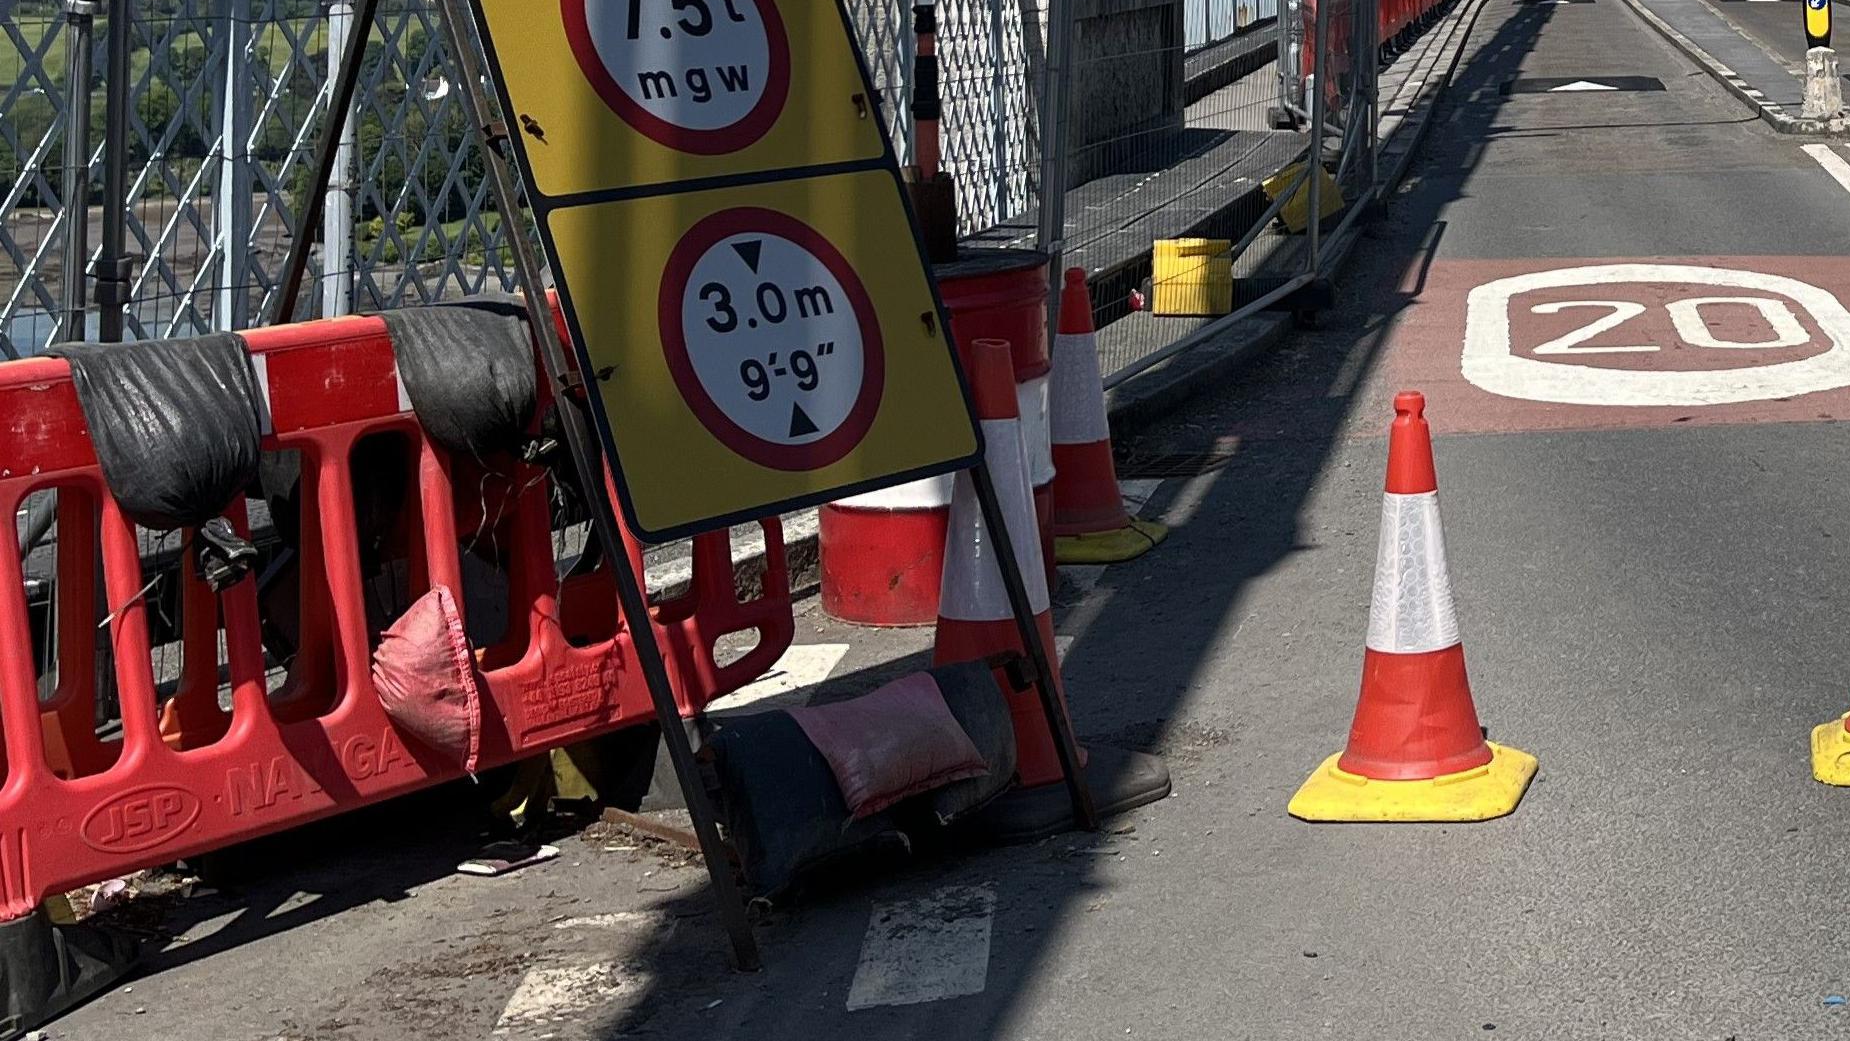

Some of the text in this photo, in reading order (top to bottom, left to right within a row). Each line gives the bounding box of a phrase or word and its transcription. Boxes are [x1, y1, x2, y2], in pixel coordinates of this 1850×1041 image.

[700, 281, 834, 333] 3.0m
[1530, 296, 1811, 355] 20
[102, 792, 183, 844] JSP
